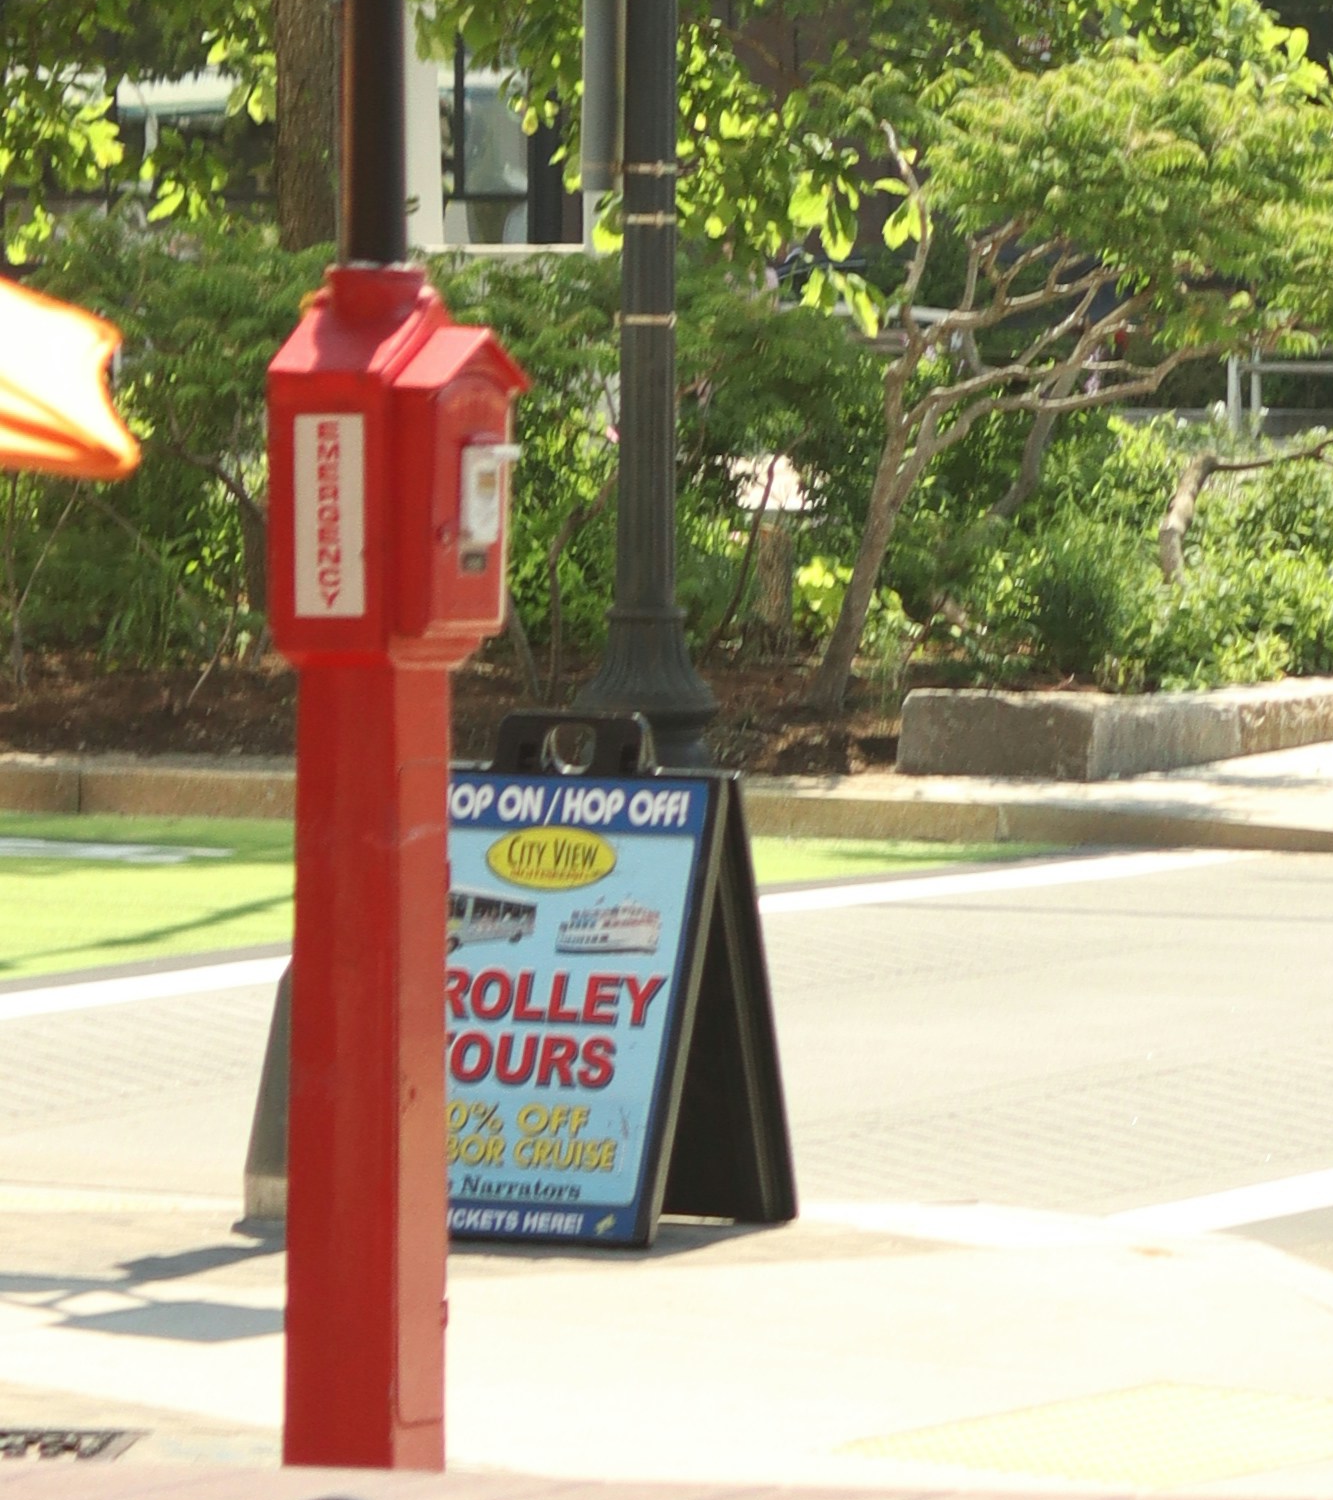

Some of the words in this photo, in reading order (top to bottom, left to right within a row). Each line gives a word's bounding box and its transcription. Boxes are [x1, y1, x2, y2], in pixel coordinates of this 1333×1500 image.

[318, 422, 340, 608] EMERGENCY
[448, 783, 494, 820] OP
[497, 785, 545, 823] ON
[561, 788, 625, 826] HOP
[628, 790, 690, 827] OFF!
[507, 834, 548, 868] CITY
[553, 838, 599, 869] VIEW
[447, 968, 667, 1027] ROLLEY
[449, 1032, 616, 1088] OURS
[447, 1098, 503, 1133] 0%
[516, 1102, 590, 1137] OFF
[513, 1138, 617, 1172] CRUISE
[461, 1174, 581, 1200] Narrators
[447, 1207, 519, 1232] ICKETS
[522, 1211, 584, 1234] HERE!
